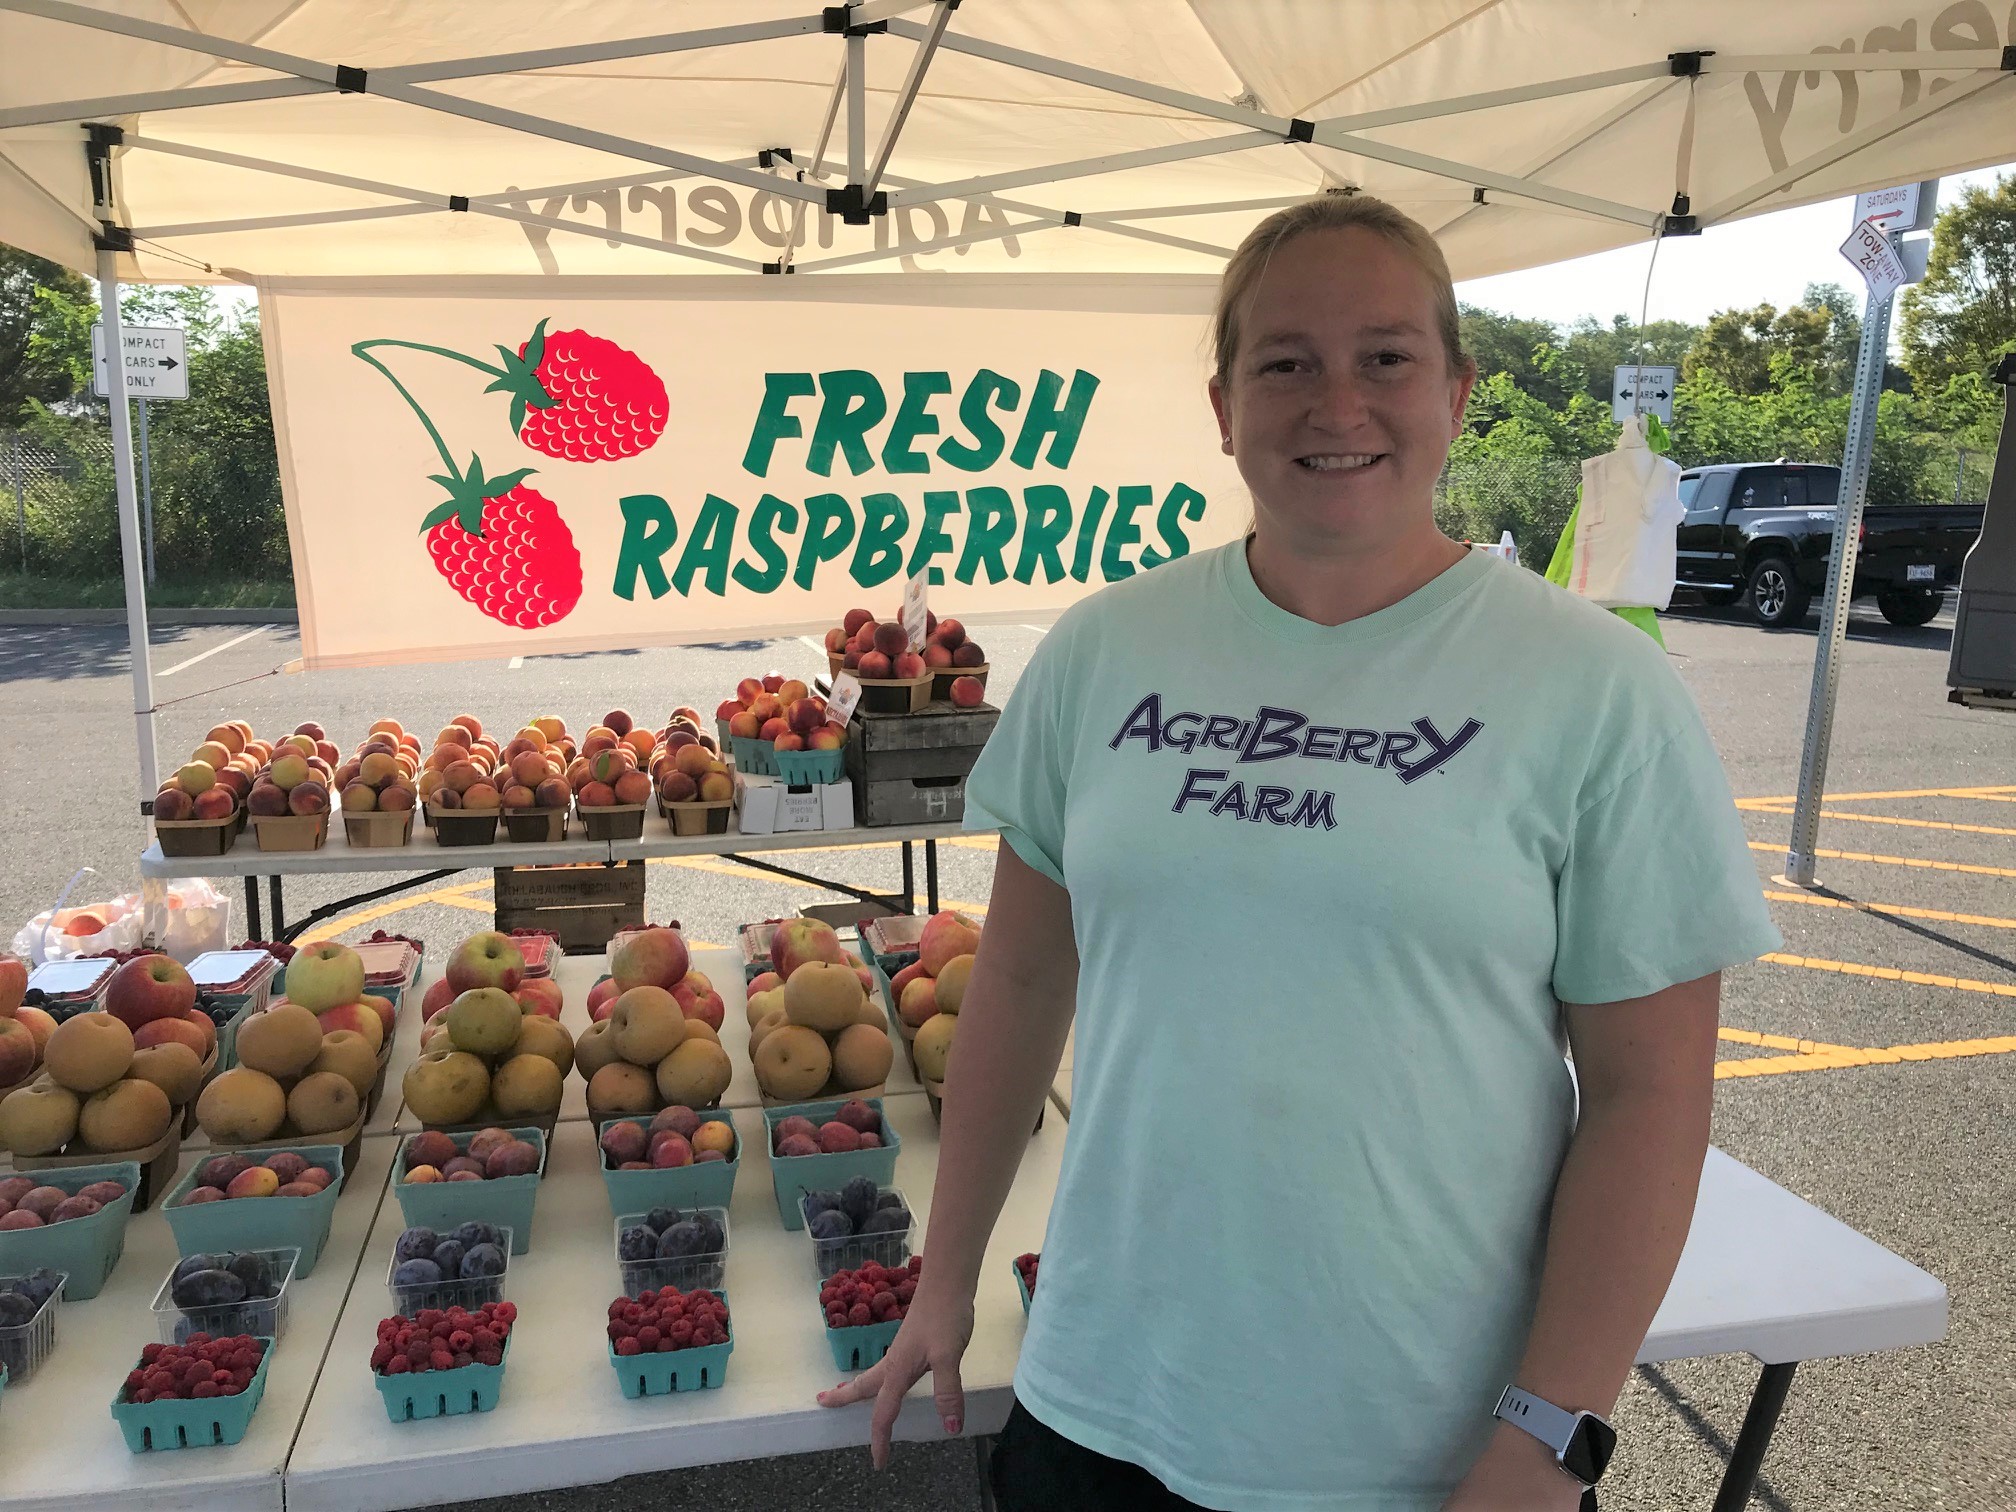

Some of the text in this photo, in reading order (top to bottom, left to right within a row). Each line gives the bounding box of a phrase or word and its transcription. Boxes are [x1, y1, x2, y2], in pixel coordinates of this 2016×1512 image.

[1866, 189, 1908, 209] SATURDAYS
[1858, 228, 1900, 283] TOW-AWAY
[1860, 252, 1883, 284] ZONE
[125, 356, 155, 368] CARS
[126, 375, 155, 387] ONLY
[742, 368, 1101, 478] FRESH
[613, 482, 1207, 601] RASPBERRIES
[1171, 768, 1338, 831] FARM
